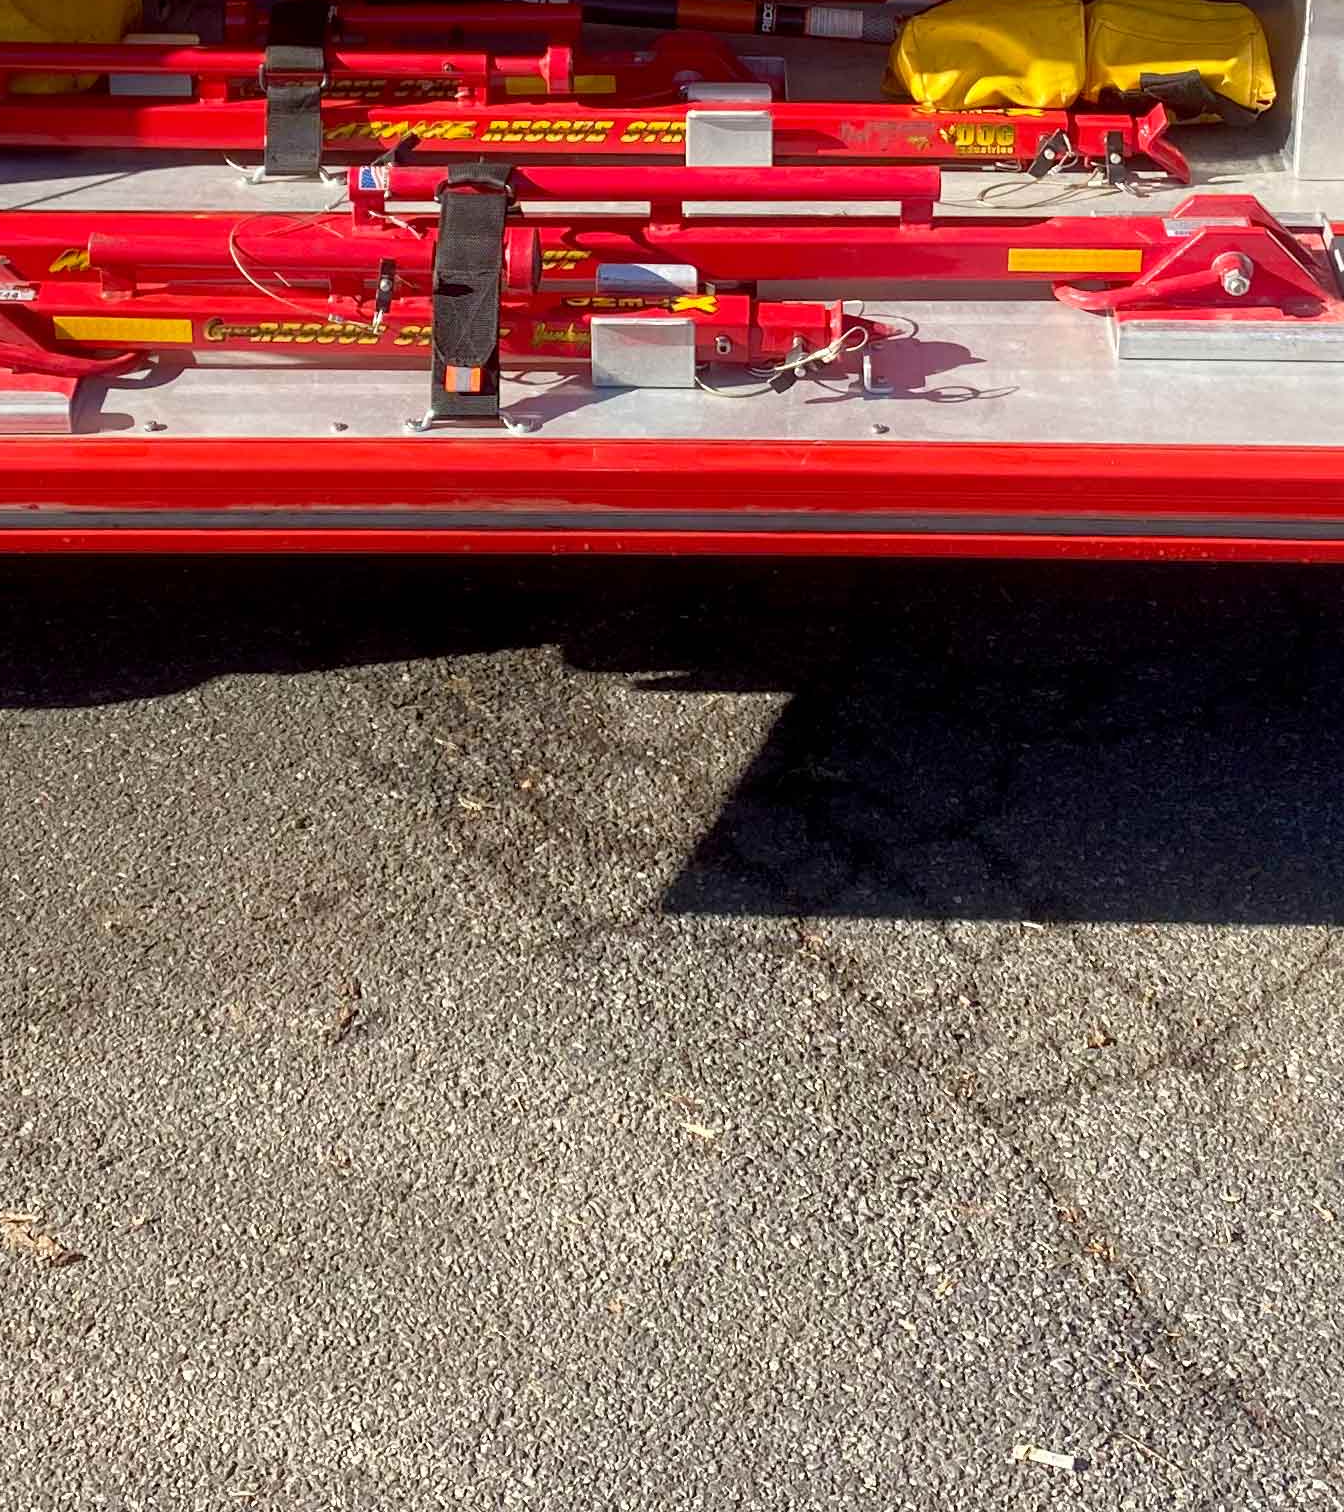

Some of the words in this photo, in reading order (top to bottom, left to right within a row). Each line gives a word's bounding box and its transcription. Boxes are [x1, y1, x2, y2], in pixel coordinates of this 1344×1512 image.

[480, 120, 614, 143] RESCUE
[620, 120, 688, 143] STR
[955, 124, 1014, 145] DOG
[249, 323, 387, 345] RESCUE
